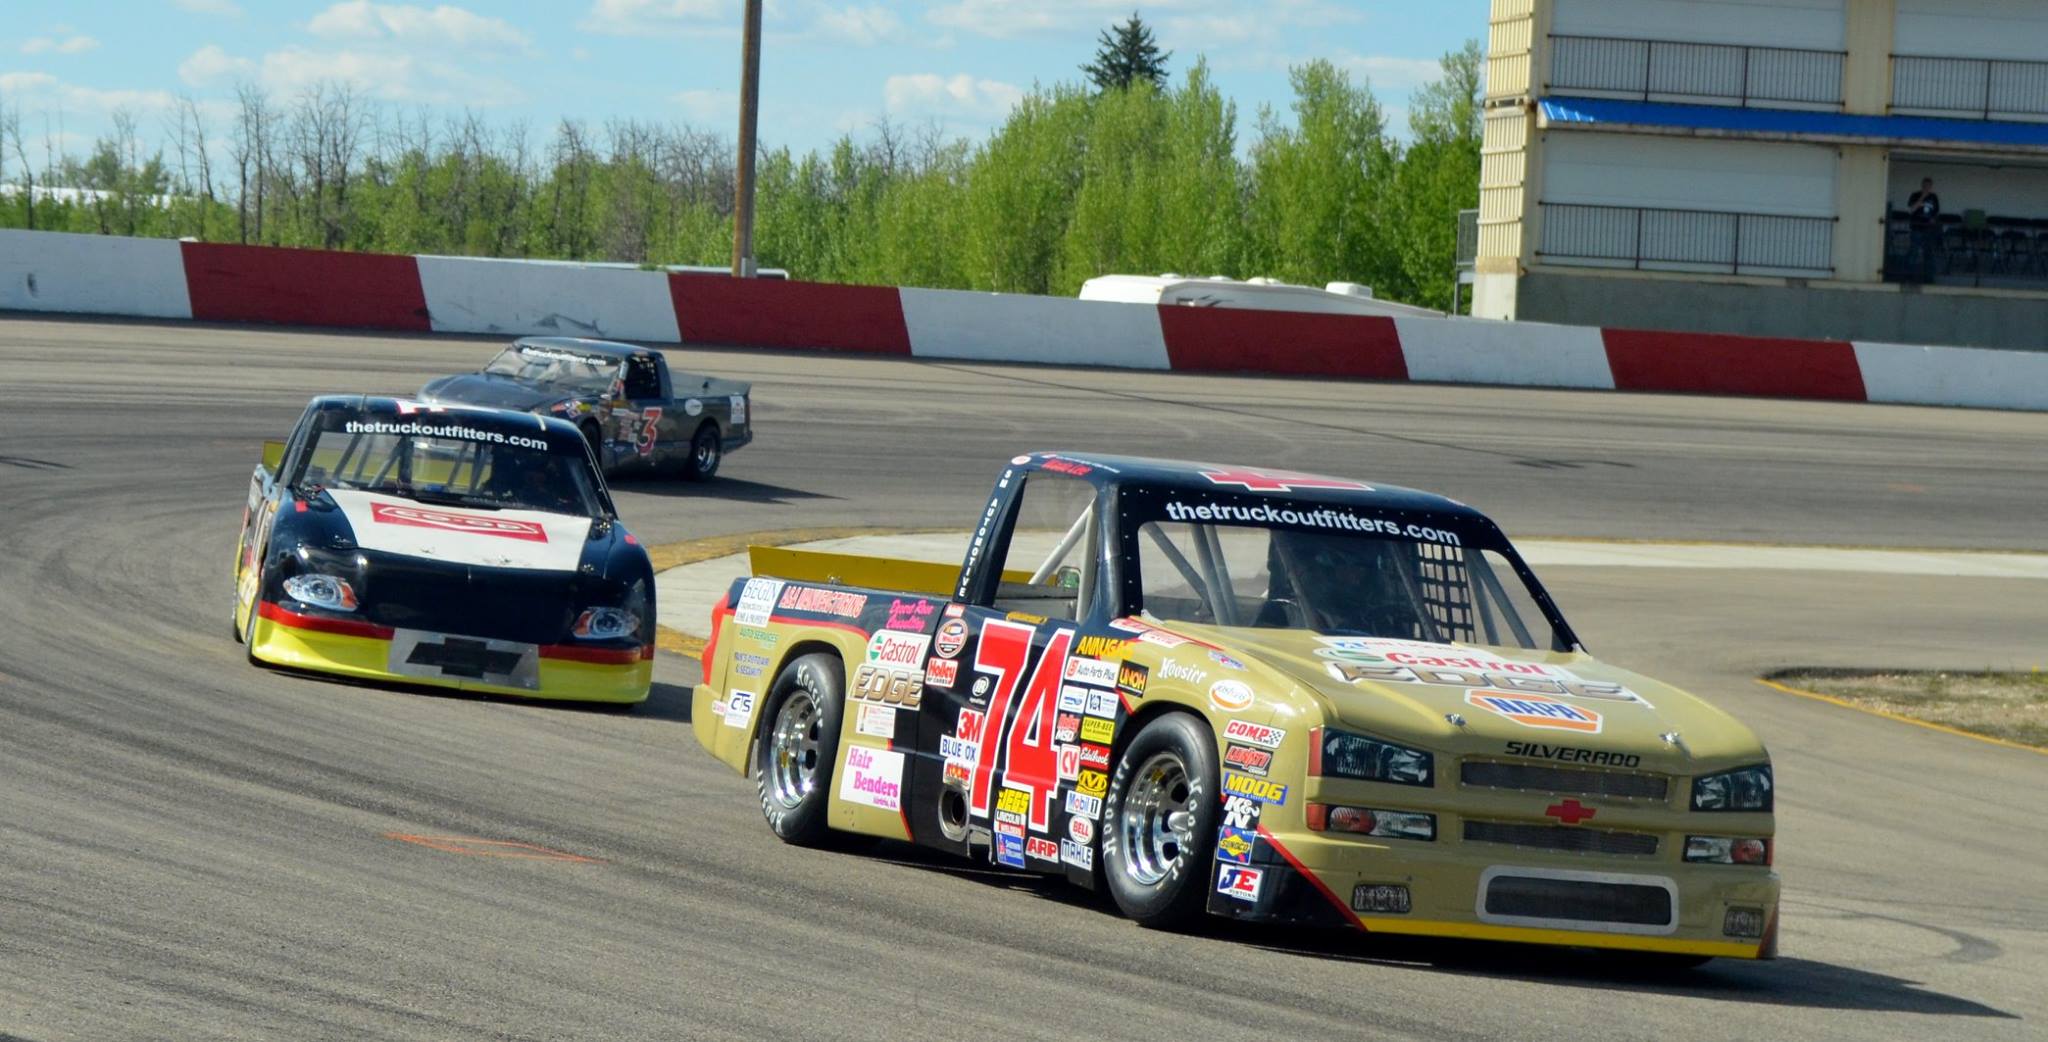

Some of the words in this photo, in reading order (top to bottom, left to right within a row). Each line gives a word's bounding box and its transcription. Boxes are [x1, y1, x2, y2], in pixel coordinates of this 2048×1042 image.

[345, 421, 548, 451] thetruckoutfitters.com
[635, 406, 663, 456] 3
[1166, 502, 1460, 546] thetruckoutfitters.com
[958, 498, 998, 597] AUTOMOTIVE
[880, 638, 920, 666] Castrol
[1385, 652, 1553, 677] Castrol
[928, 659, 956, 684] Holley
[1078, 664, 1090, 677] Auto
[1103, 667, 1116, 681] Plus
[1119, 667, 1147, 691] UNOH
[1157, 656, 1208, 685] Hoosier
[1333, 662, 1640, 702] EDGE
[854, 666, 924, 708] EDGE
[1482, 696, 1590, 723] NAPA
[958, 710, 985, 743] 3M
[970, 617, 1076, 833] 74
[1227, 721, 1270, 740] COMP
[848, 747, 873, 770] Hair
[942, 738, 962, 758] BLUE
[965, 745, 977, 763] OX
[1062, 750, 1078, 775] CV
[1504, 741, 1641, 768] SILVERADO
[853, 770, 899, 798] Benders
[1224, 773, 1286, 801] MOOG
[1068, 792, 1090, 813] Mobil
[1072, 820, 1089, 838] BELL
[1027, 836, 1057, 858] ARP
[1061, 840, 1092, 865] MAHLE
[1220, 838, 1252, 853] SUNOCO
[1219, 867, 1258, 892] JE
